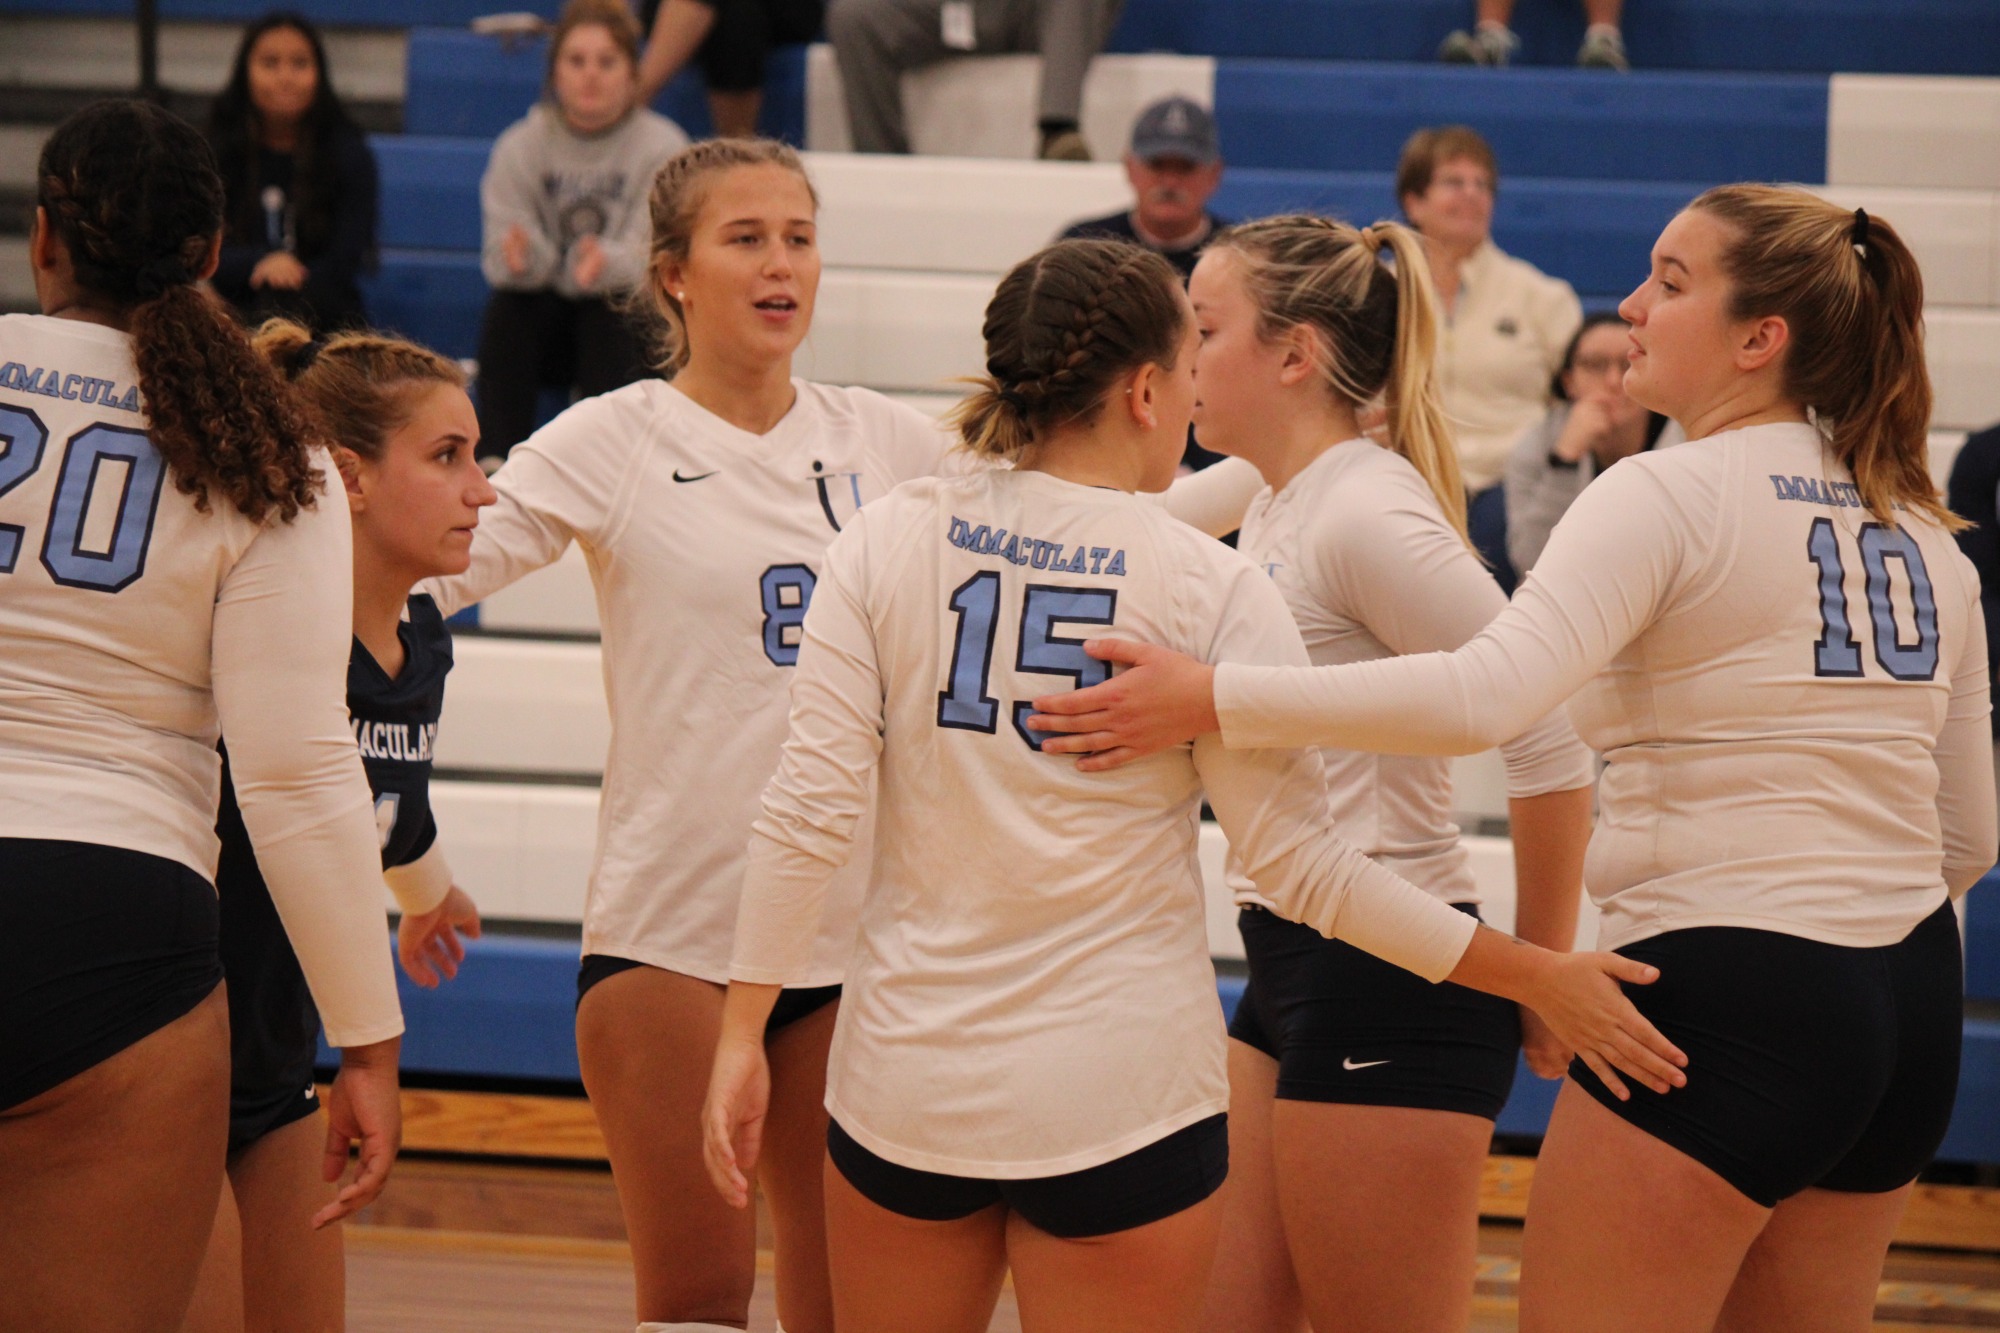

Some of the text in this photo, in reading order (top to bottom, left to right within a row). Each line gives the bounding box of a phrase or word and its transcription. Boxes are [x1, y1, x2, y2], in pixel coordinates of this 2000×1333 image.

[1769, 475, 1875, 508] IMMACU
[948, 515, 1127, 577] IMMACULATA
[759, 563, 818, 667] 8
[1807, 516, 1940, 681] 10
[937, 569, 1118, 755] 15
